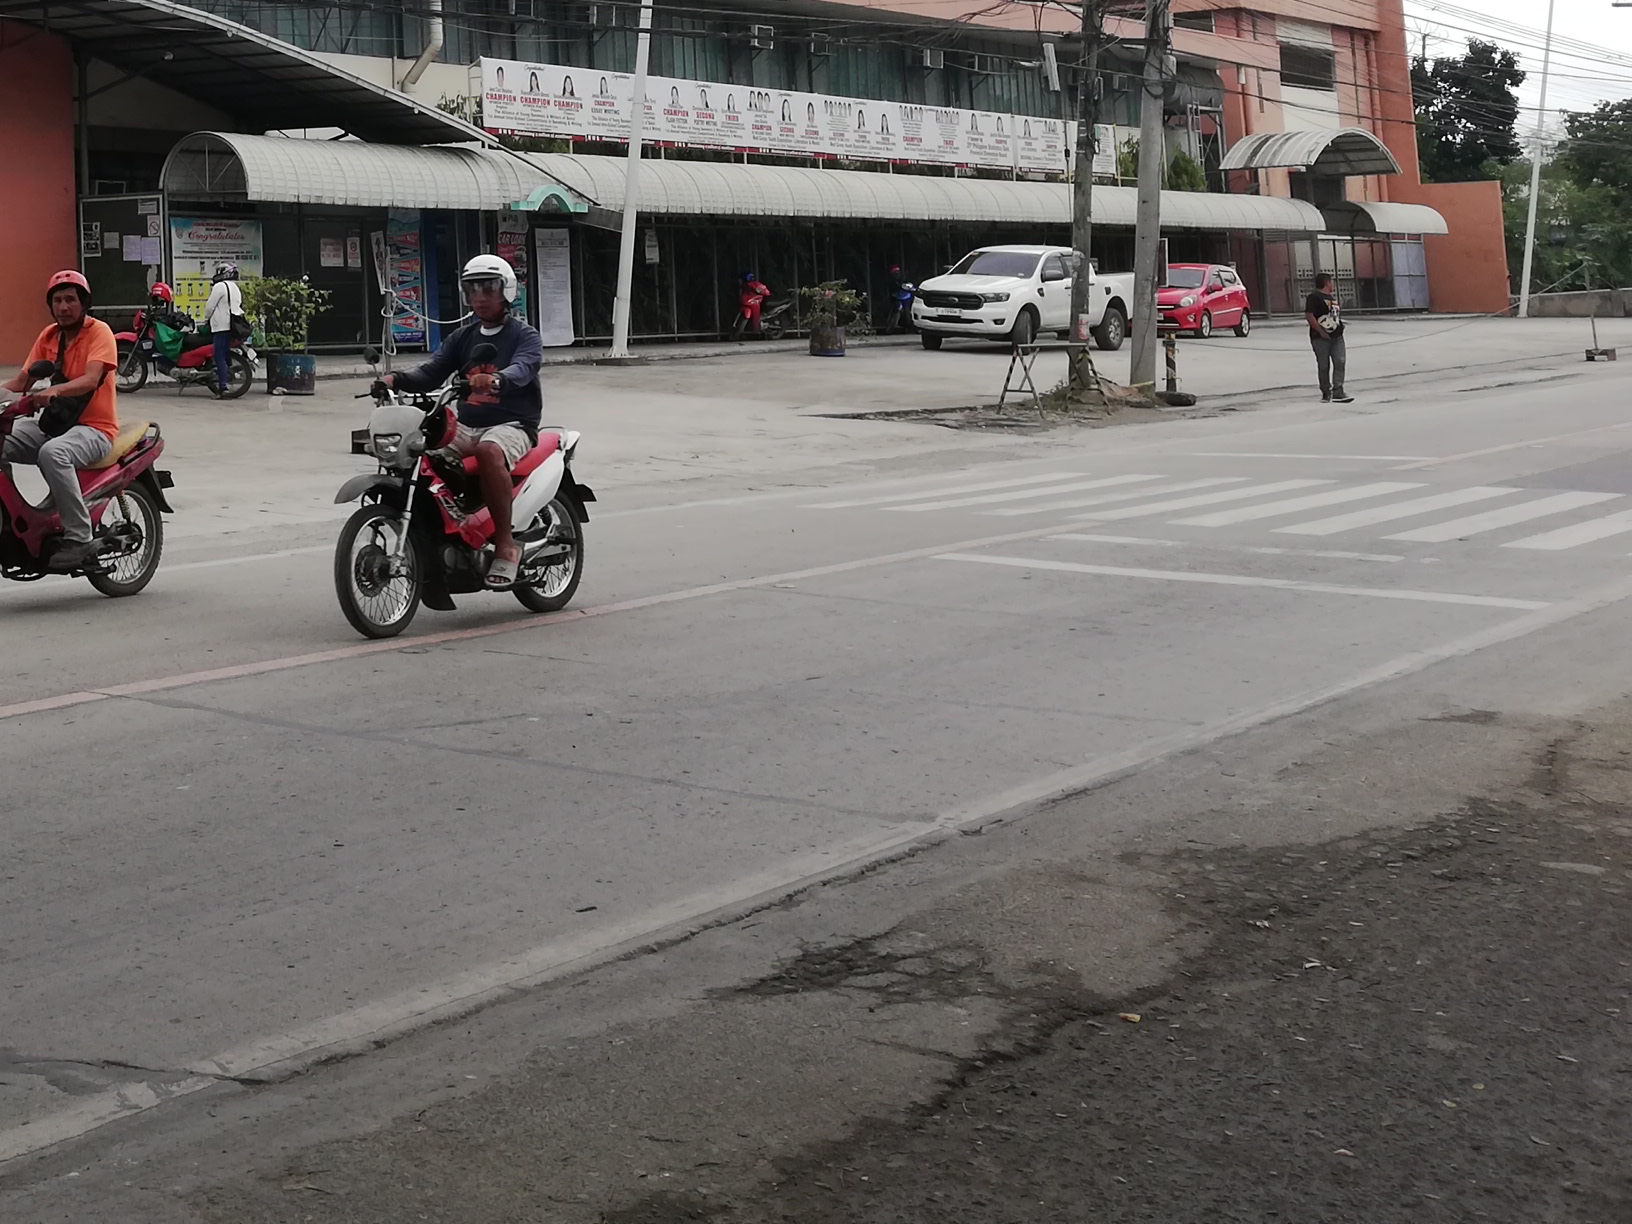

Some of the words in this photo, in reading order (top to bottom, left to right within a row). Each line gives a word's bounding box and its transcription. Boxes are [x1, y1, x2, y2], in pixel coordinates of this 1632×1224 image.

[486, 92, 516, 102] CHAMPION
[520, 97, 550, 106] CHAMPION
[554, 100, 583, 109] CHAMPION
[664, 108, 688, 117] CHAMPION
[188, 230, 245, 242] Congratulates
